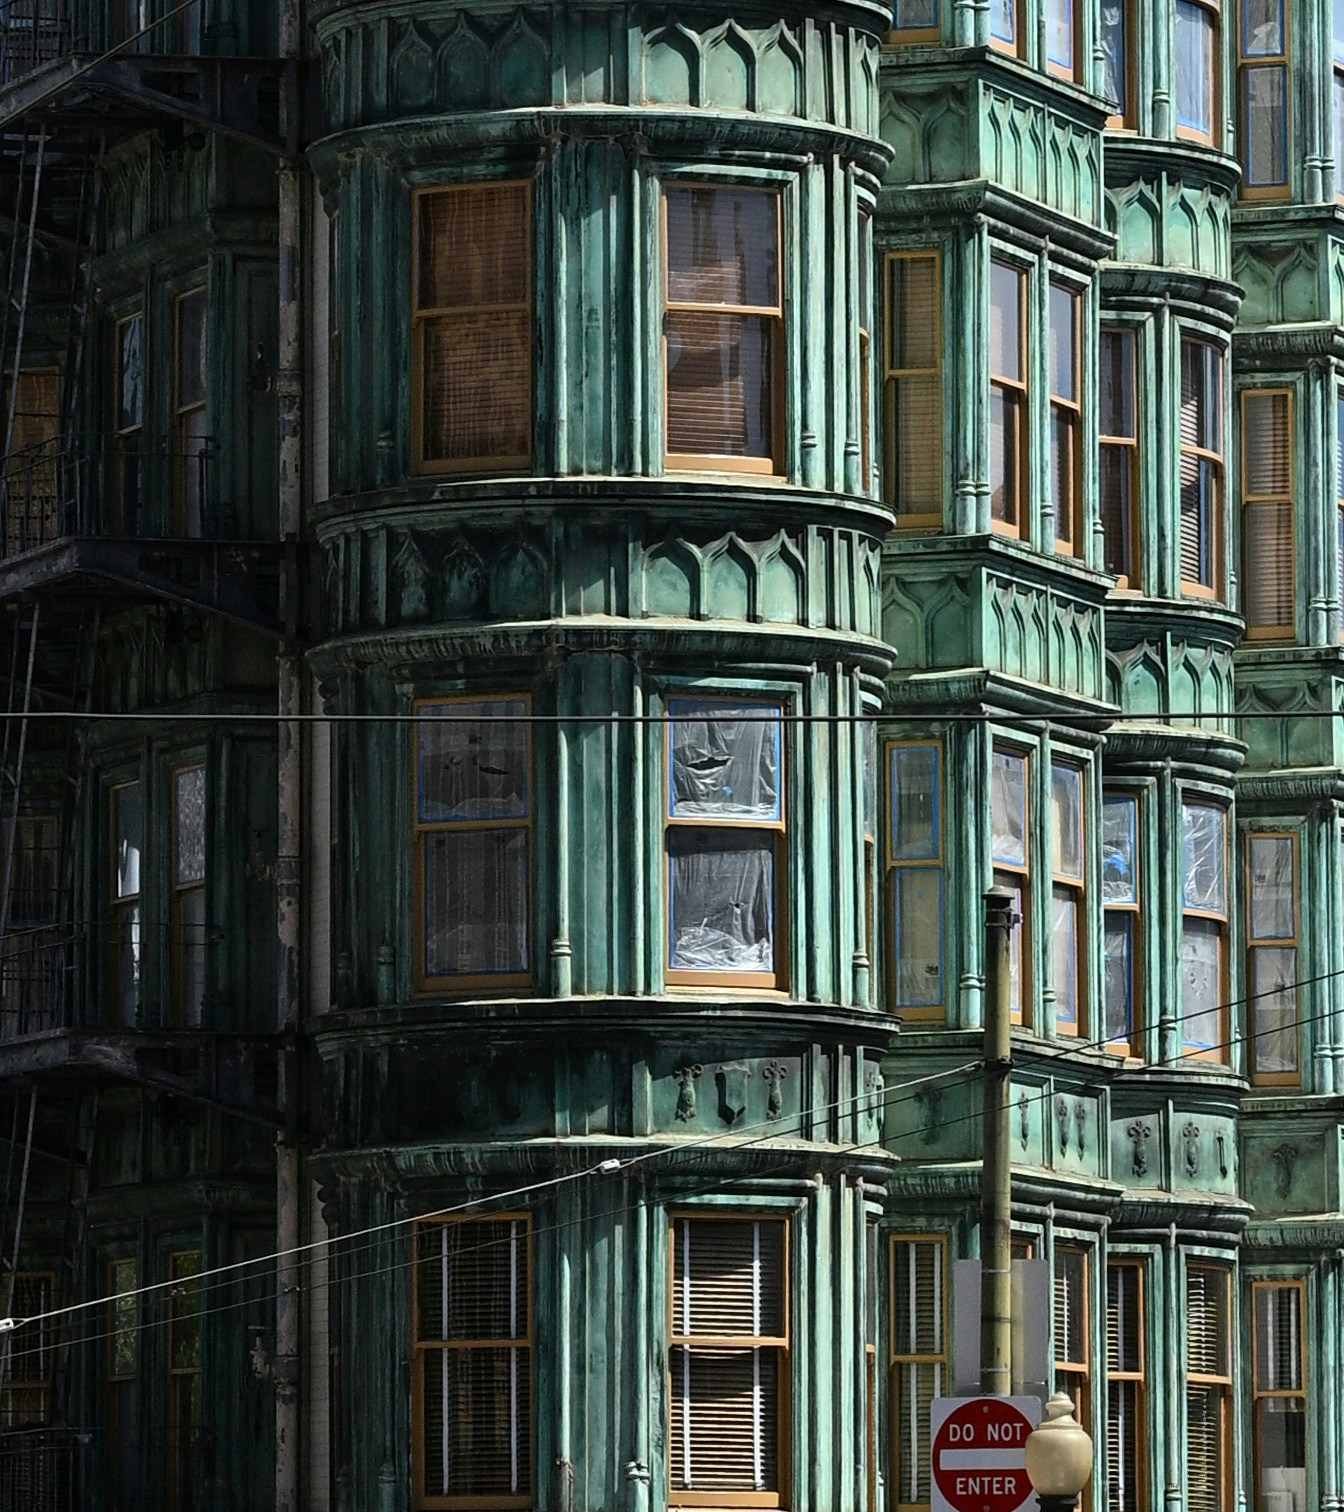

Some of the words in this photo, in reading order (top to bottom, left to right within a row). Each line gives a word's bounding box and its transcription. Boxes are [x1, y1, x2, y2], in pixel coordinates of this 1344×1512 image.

[949, 1424, 974, 1442] DO
[987, 1423, 1024, 1441] NOT
[956, 1477, 1016, 1495] ENTER
